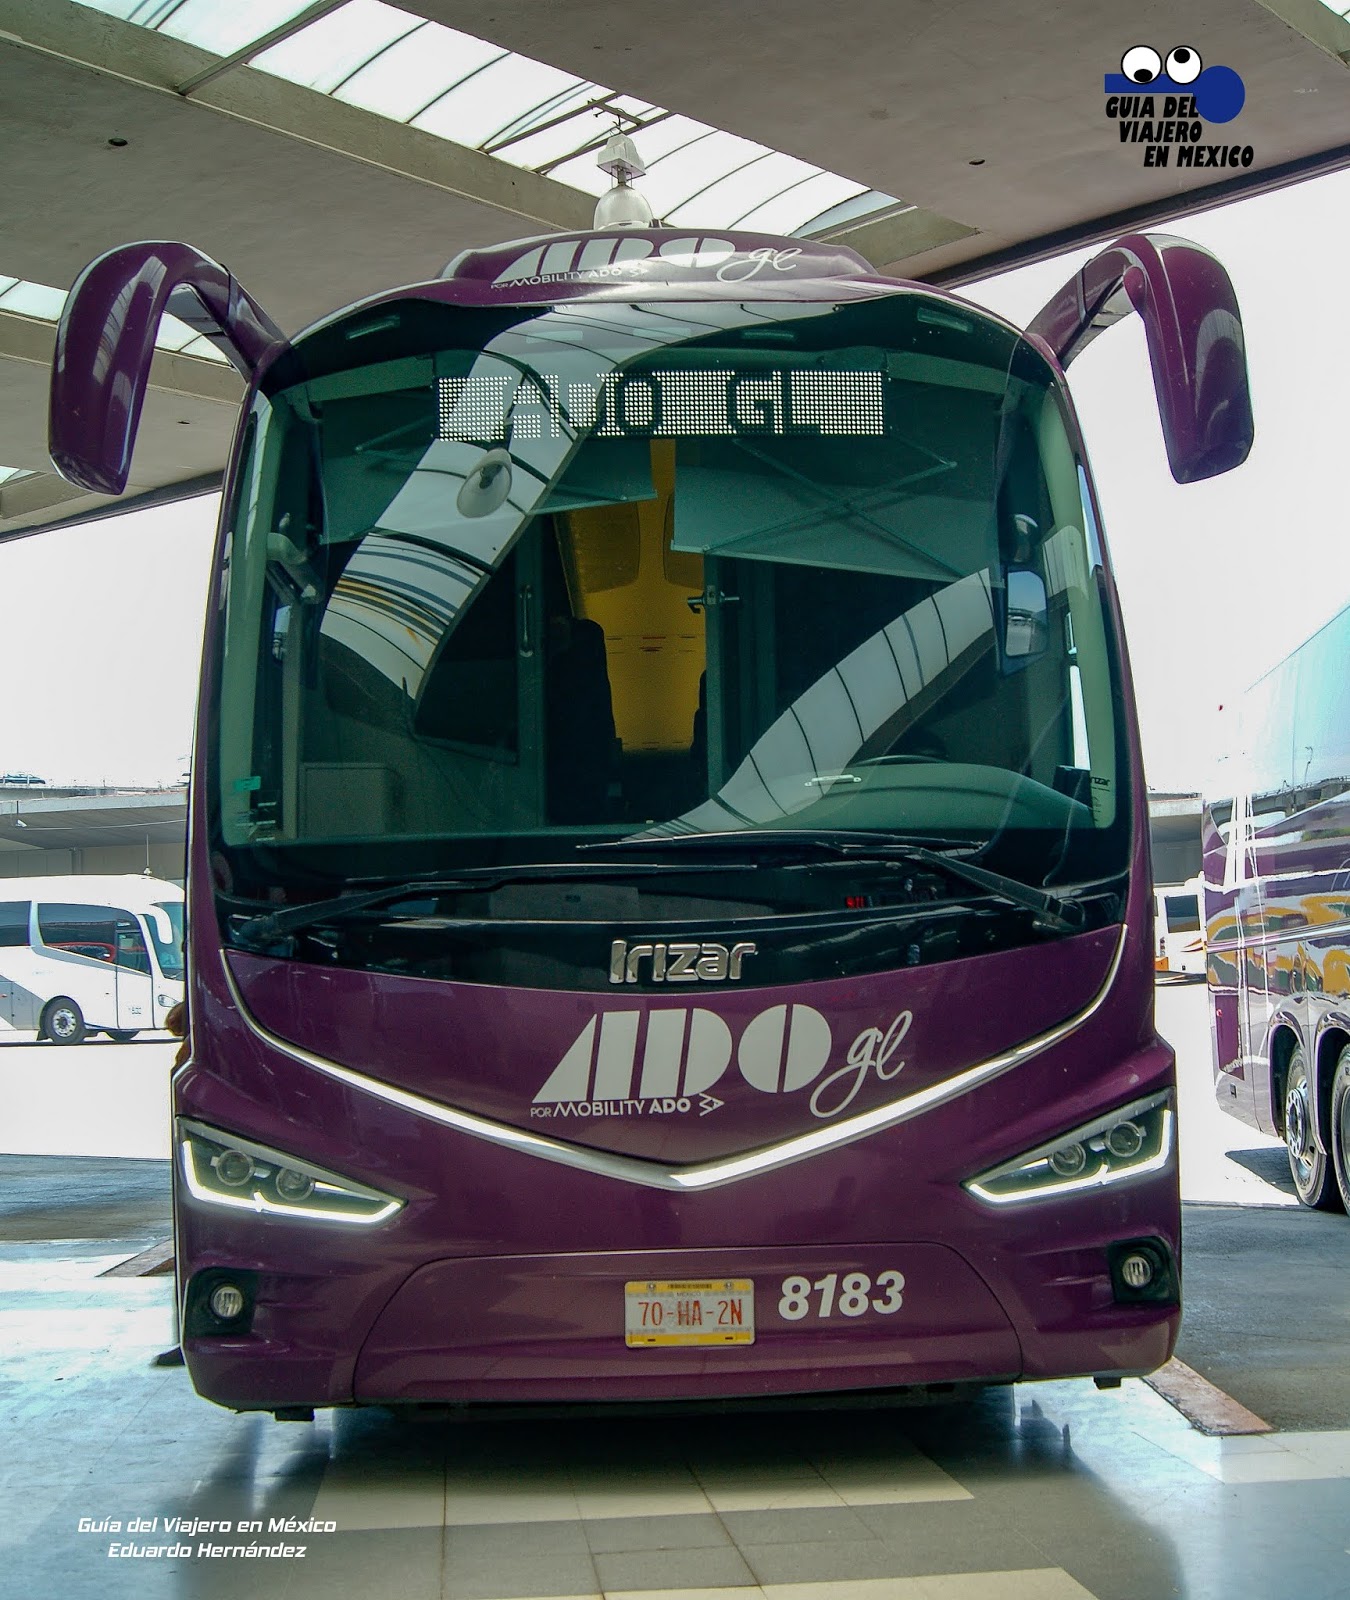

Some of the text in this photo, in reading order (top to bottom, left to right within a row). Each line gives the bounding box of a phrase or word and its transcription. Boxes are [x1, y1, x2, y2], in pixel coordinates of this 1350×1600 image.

[490, 267, 622, 290] POR MOBILITY ADO
[491, 237, 736, 284] ADO
[727, 370, 821, 435] GL
[609, 939, 758, 984] Irizar
[532, 1003, 913, 1118] ADO gl
[530, 1098, 691, 1118] POR MOBILITY ADO
[638, 1299, 743, 1326] 70-HA-2N
[778, 1269, 906, 1321] 8183
